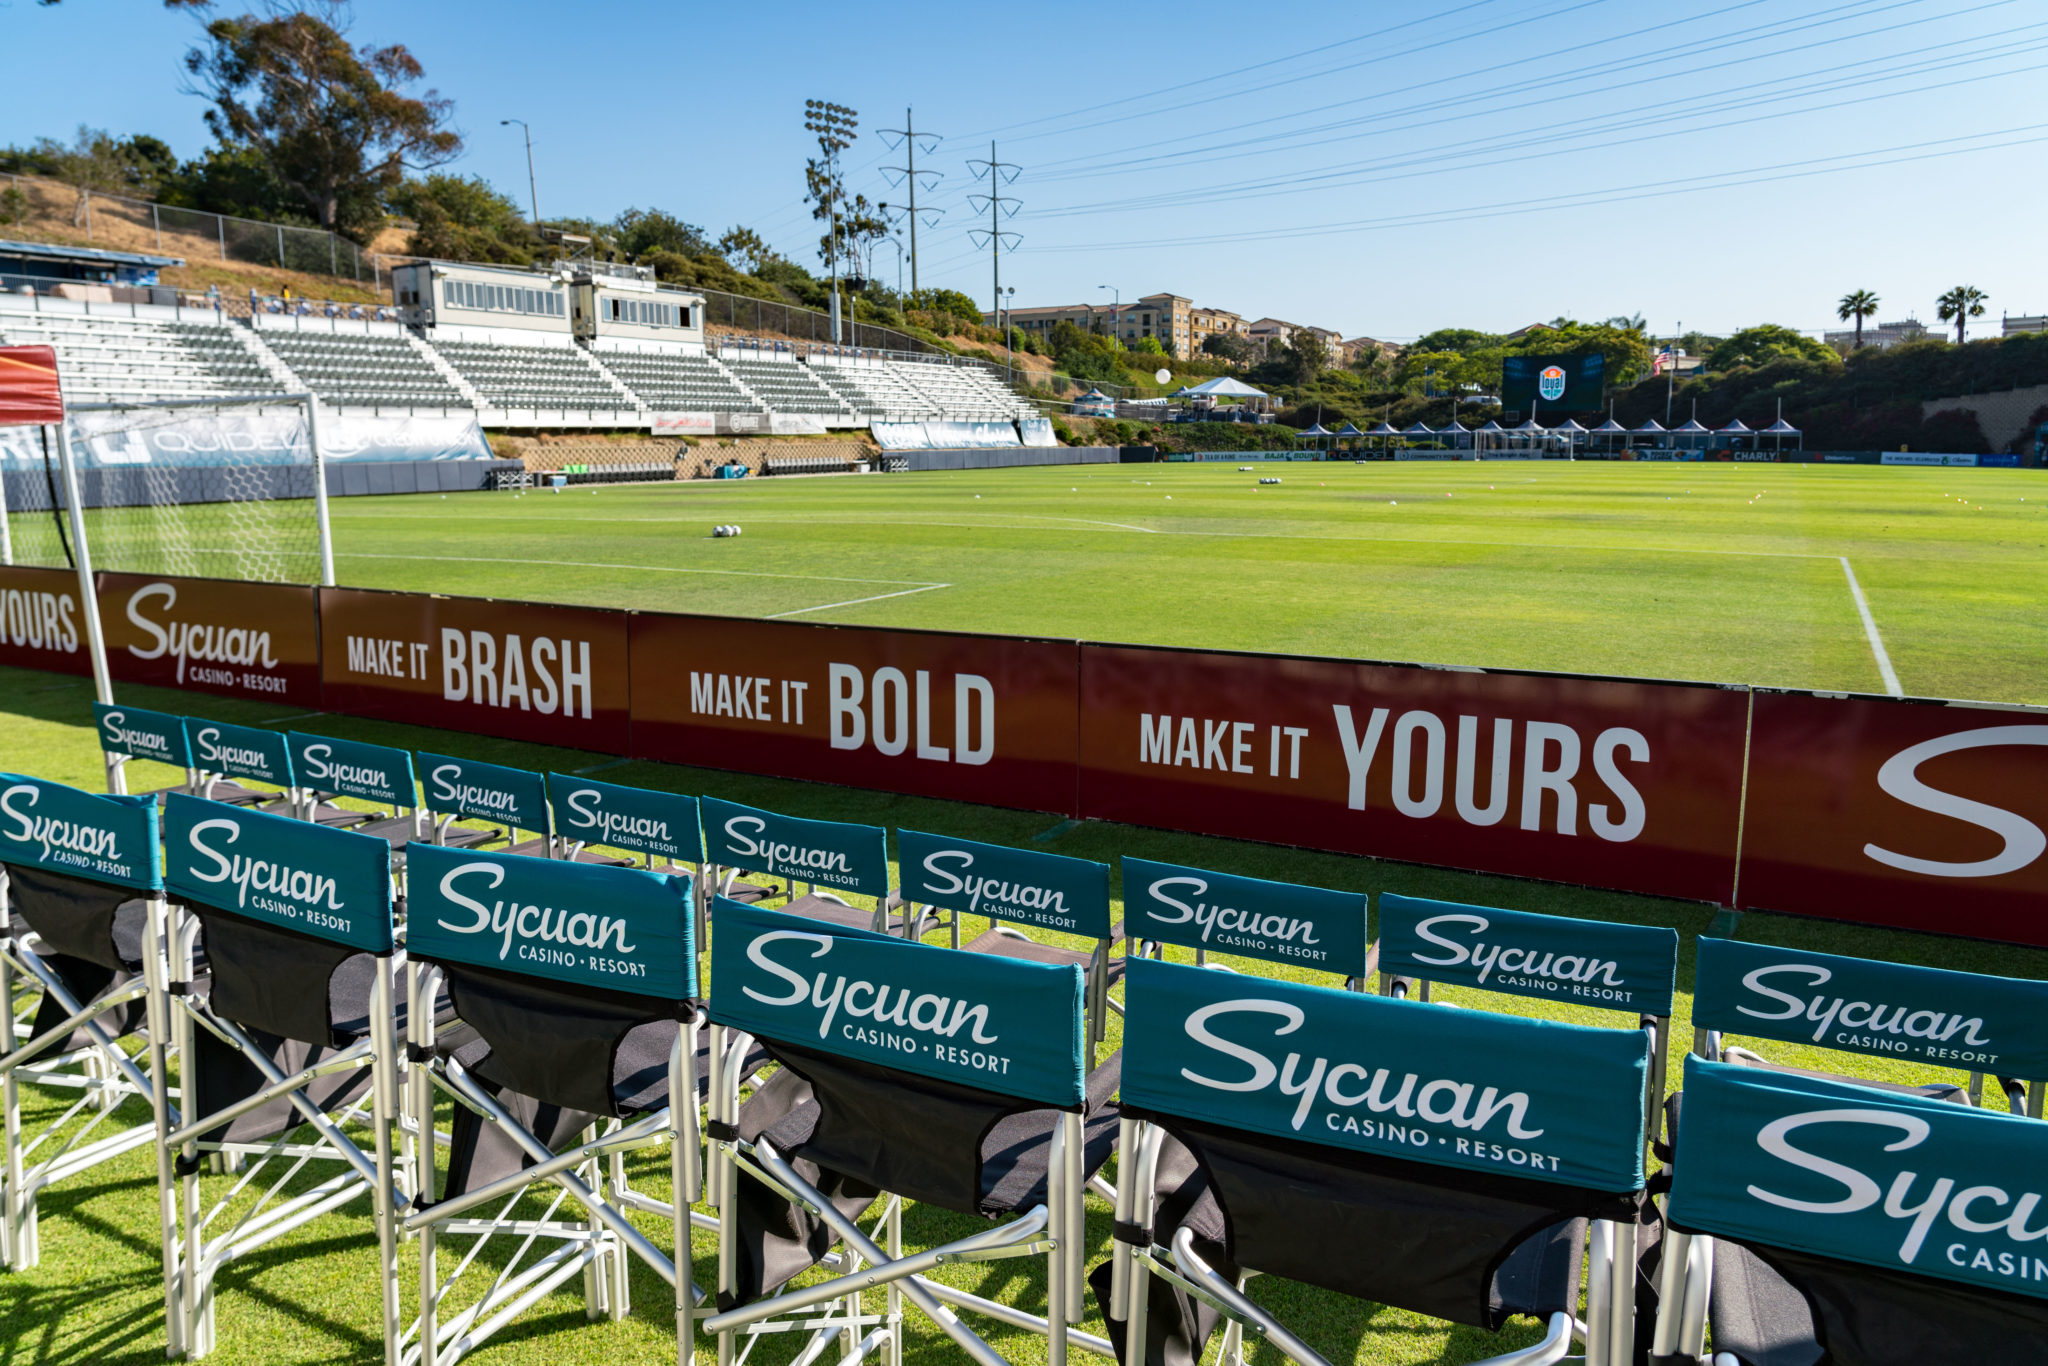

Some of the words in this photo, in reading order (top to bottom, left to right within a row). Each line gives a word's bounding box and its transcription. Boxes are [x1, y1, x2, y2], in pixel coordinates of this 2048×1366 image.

[1734, 451, 1776, 462] CHARLY
[0, 589, 78, 653] YOURS
[127, 583, 278, 684] Sycuan
[190, 666, 234, 687] CASINO
[243, 674, 287, 693] RESORT
[348, 636, 404, 678] MAKE
[410, 643, 428, 681] IT
[442, 628, 592, 720] BRASH
[103, 712, 168, 753] Sycuan
[690, 672, 771, 722] MAKE
[782, 679, 808, 725] IT
[829, 663, 995, 766] BOLD
[198, 728, 268, 772] Sycuan
[304, 744, 390, 791] Sycuan
[1141, 713, 1254, 774] MAKE
[1270, 726, 1308, 779] IT
[1333, 704, 1650, 844] YOURS
[341, 783, 367, 795] CASINO
[371, 788, 395, 799] RESORT
[432, 765, 518, 813] Sycuan
[1, 785, 122, 862] Sycuan
[466, 806, 492, 817] CASINO
[495, 813, 521, 824] RESORT
[568, 790, 672, 842] Sycuan
[53, 850, 90, 867] CASINO
[96, 860, 131, 878] RESORT
[190, 819, 344, 909] Sycuan
[612, 833, 646, 846] CASINO
[649, 841, 678, 854] RESORT
[725, 816, 852, 872] Sycuan
[778, 865, 814, 879] CASINO
[823, 873, 859, 886] RESORT
[923, 851, 1069, 912] Sycuan
[252, 895, 297, 918] CASINO
[306, 909, 351, 932] RESORT
[438, 862, 635, 961] Sycuan
[983, 903, 1025, 918] CASINO
[1036, 914, 1077, 928] RESORT
[1147, 877, 1319, 943] Sycuan
[519, 944, 576, 967] CASINO
[589, 955, 647, 976] RESORT
[1218, 933, 1267, 950] CASINO
[1278, 944, 1327, 961] RESORT
[1412, 914, 1624, 985] Sycuan
[739, 930, 998, 1044] Sycuan
[1497, 974, 1558, 992] CASINO
[1573, 985, 1632, 1003] RESORT
[1736, 964, 1989, 1042] Sycuan
[843, 1025, 917, 1053] CASINO
[935, 1043, 1010, 1075] RESORT
[1181, 999, 1544, 1139] Sycuan
[1837, 1032, 1909, 1053] CASINO
[1926, 1046, 1999, 1064] RESORT
[1326, 1113, 1406, 1144] CASINO
[1456, 1137, 1560, 1172] RESORT
